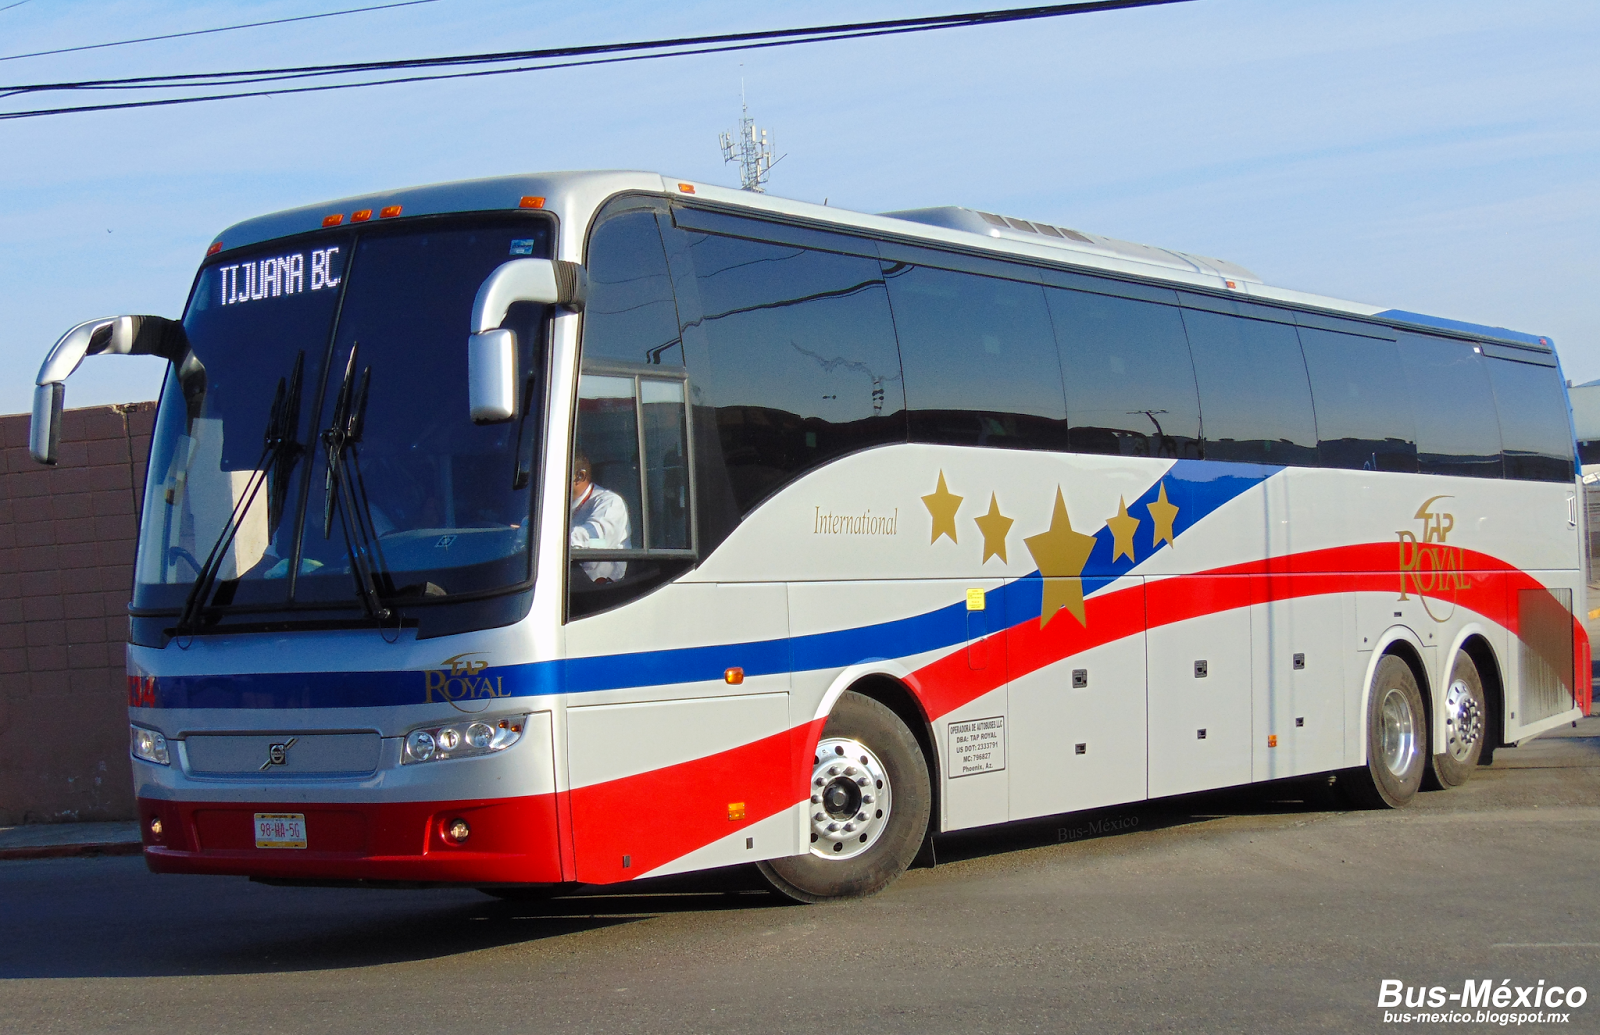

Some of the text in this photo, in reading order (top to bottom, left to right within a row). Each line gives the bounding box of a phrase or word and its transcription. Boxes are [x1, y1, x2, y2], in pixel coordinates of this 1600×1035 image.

[220, 253, 303, 305] TIJUANA
[814, 506, 898, 535] International
[1414, 502, 1454, 542] TAP
[441, 656, 489, 676] TAP
[950, 724, 971, 734] OPERADORA
[970, 734, 979, 742] TAP
[981, 732, 997, 740] ROYAL
[977, 741, 998, 751] 2333791
[963, 755, 973, 763] MC:
